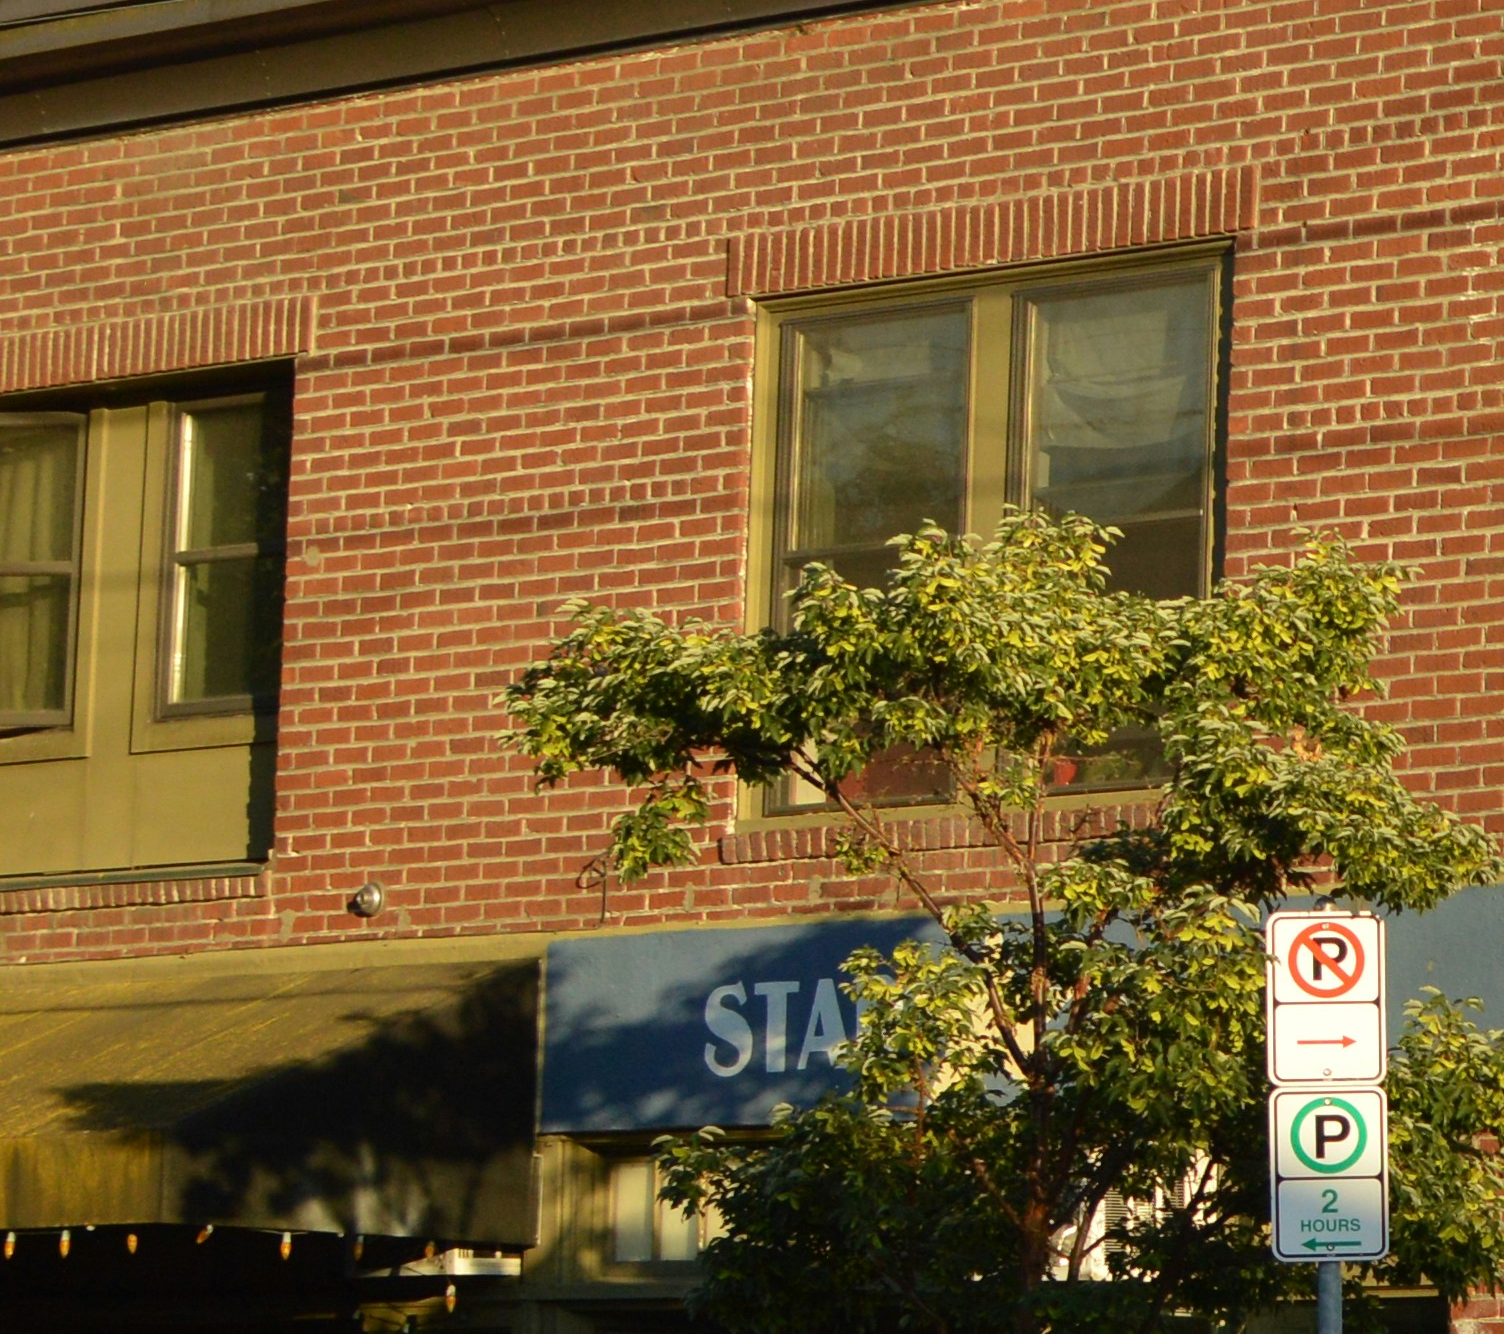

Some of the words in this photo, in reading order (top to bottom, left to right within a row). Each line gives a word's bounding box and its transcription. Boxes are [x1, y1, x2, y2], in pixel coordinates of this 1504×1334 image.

[1315, 1114, 1350, 1159] P
[1321, 1189, 1339, 1213] 2
[1301, 1218, 1361, 1232] HOURS
